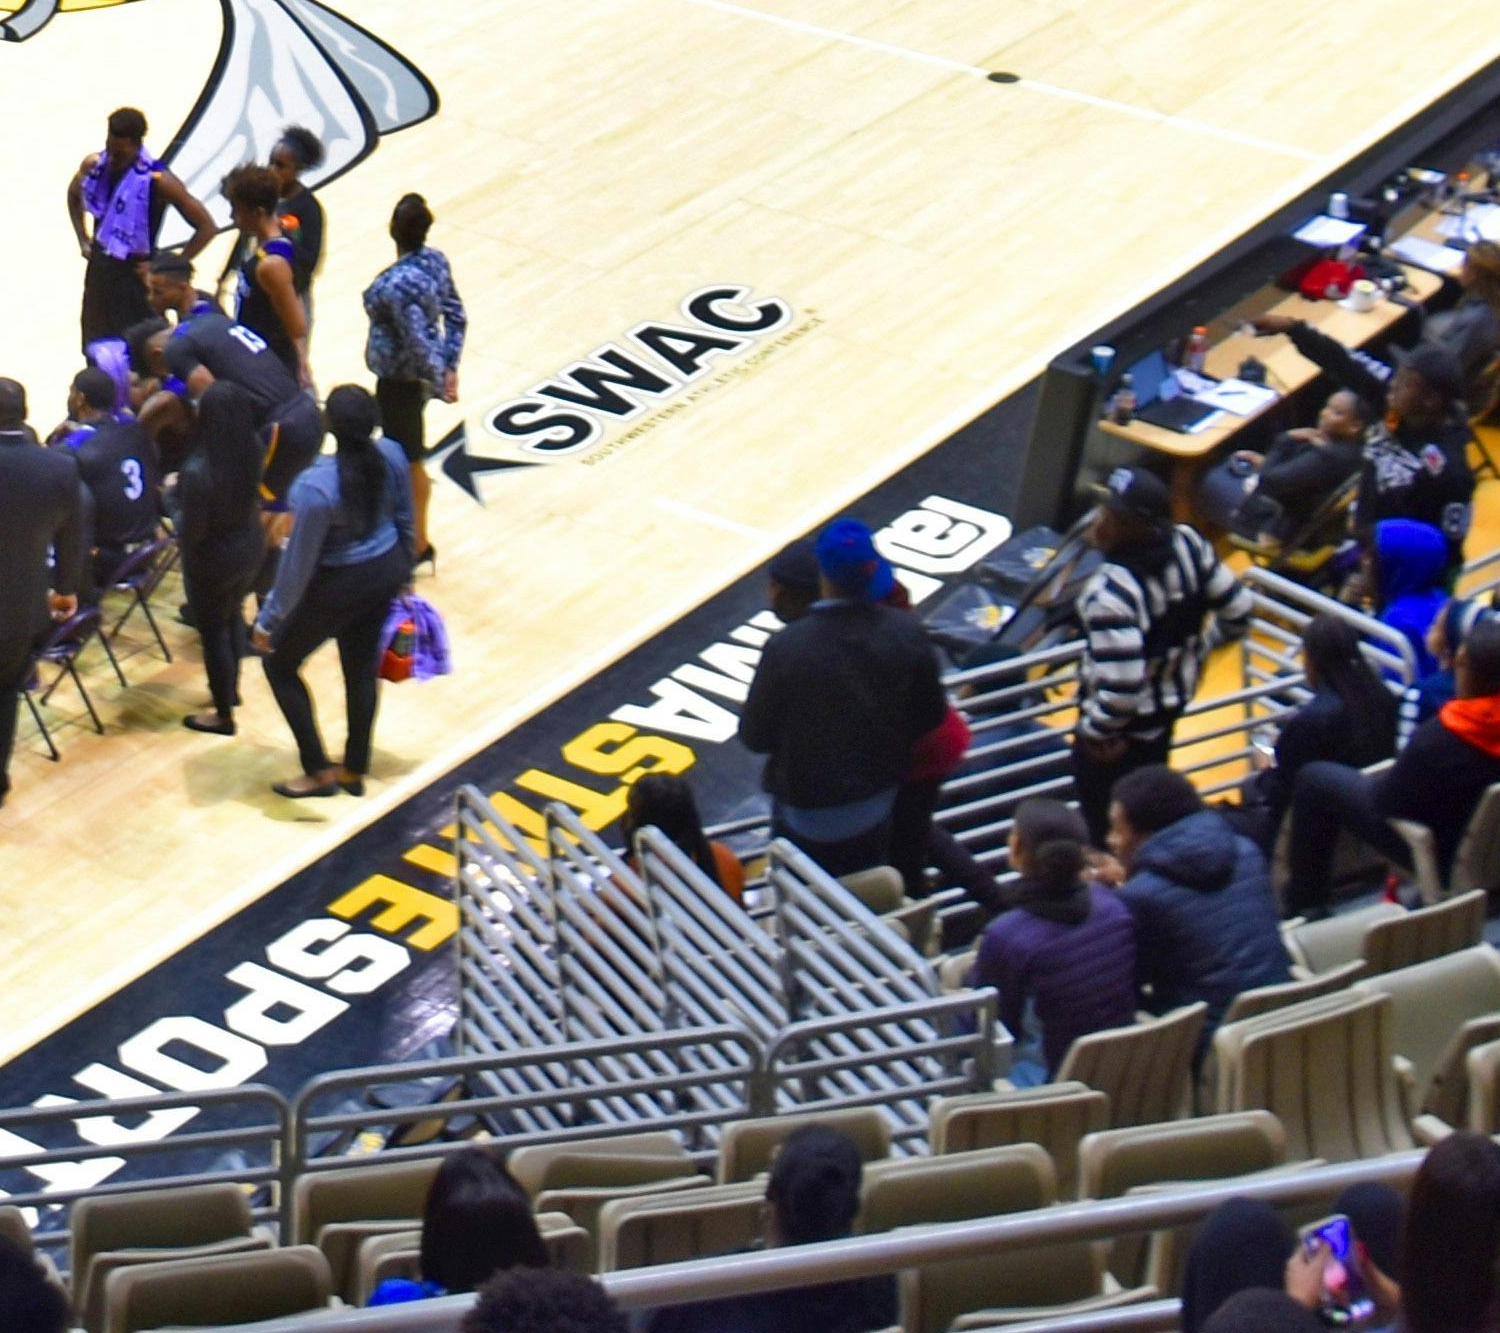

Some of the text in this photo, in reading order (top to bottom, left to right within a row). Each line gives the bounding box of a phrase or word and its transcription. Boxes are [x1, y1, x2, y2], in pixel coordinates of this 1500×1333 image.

[483, 283, 793, 456] SWAC
[580, 397, 690, 468] SOUTHWESTERN
[742, 316, 827, 379] CONFERENCE
[120, 457, 143, 502] 3
